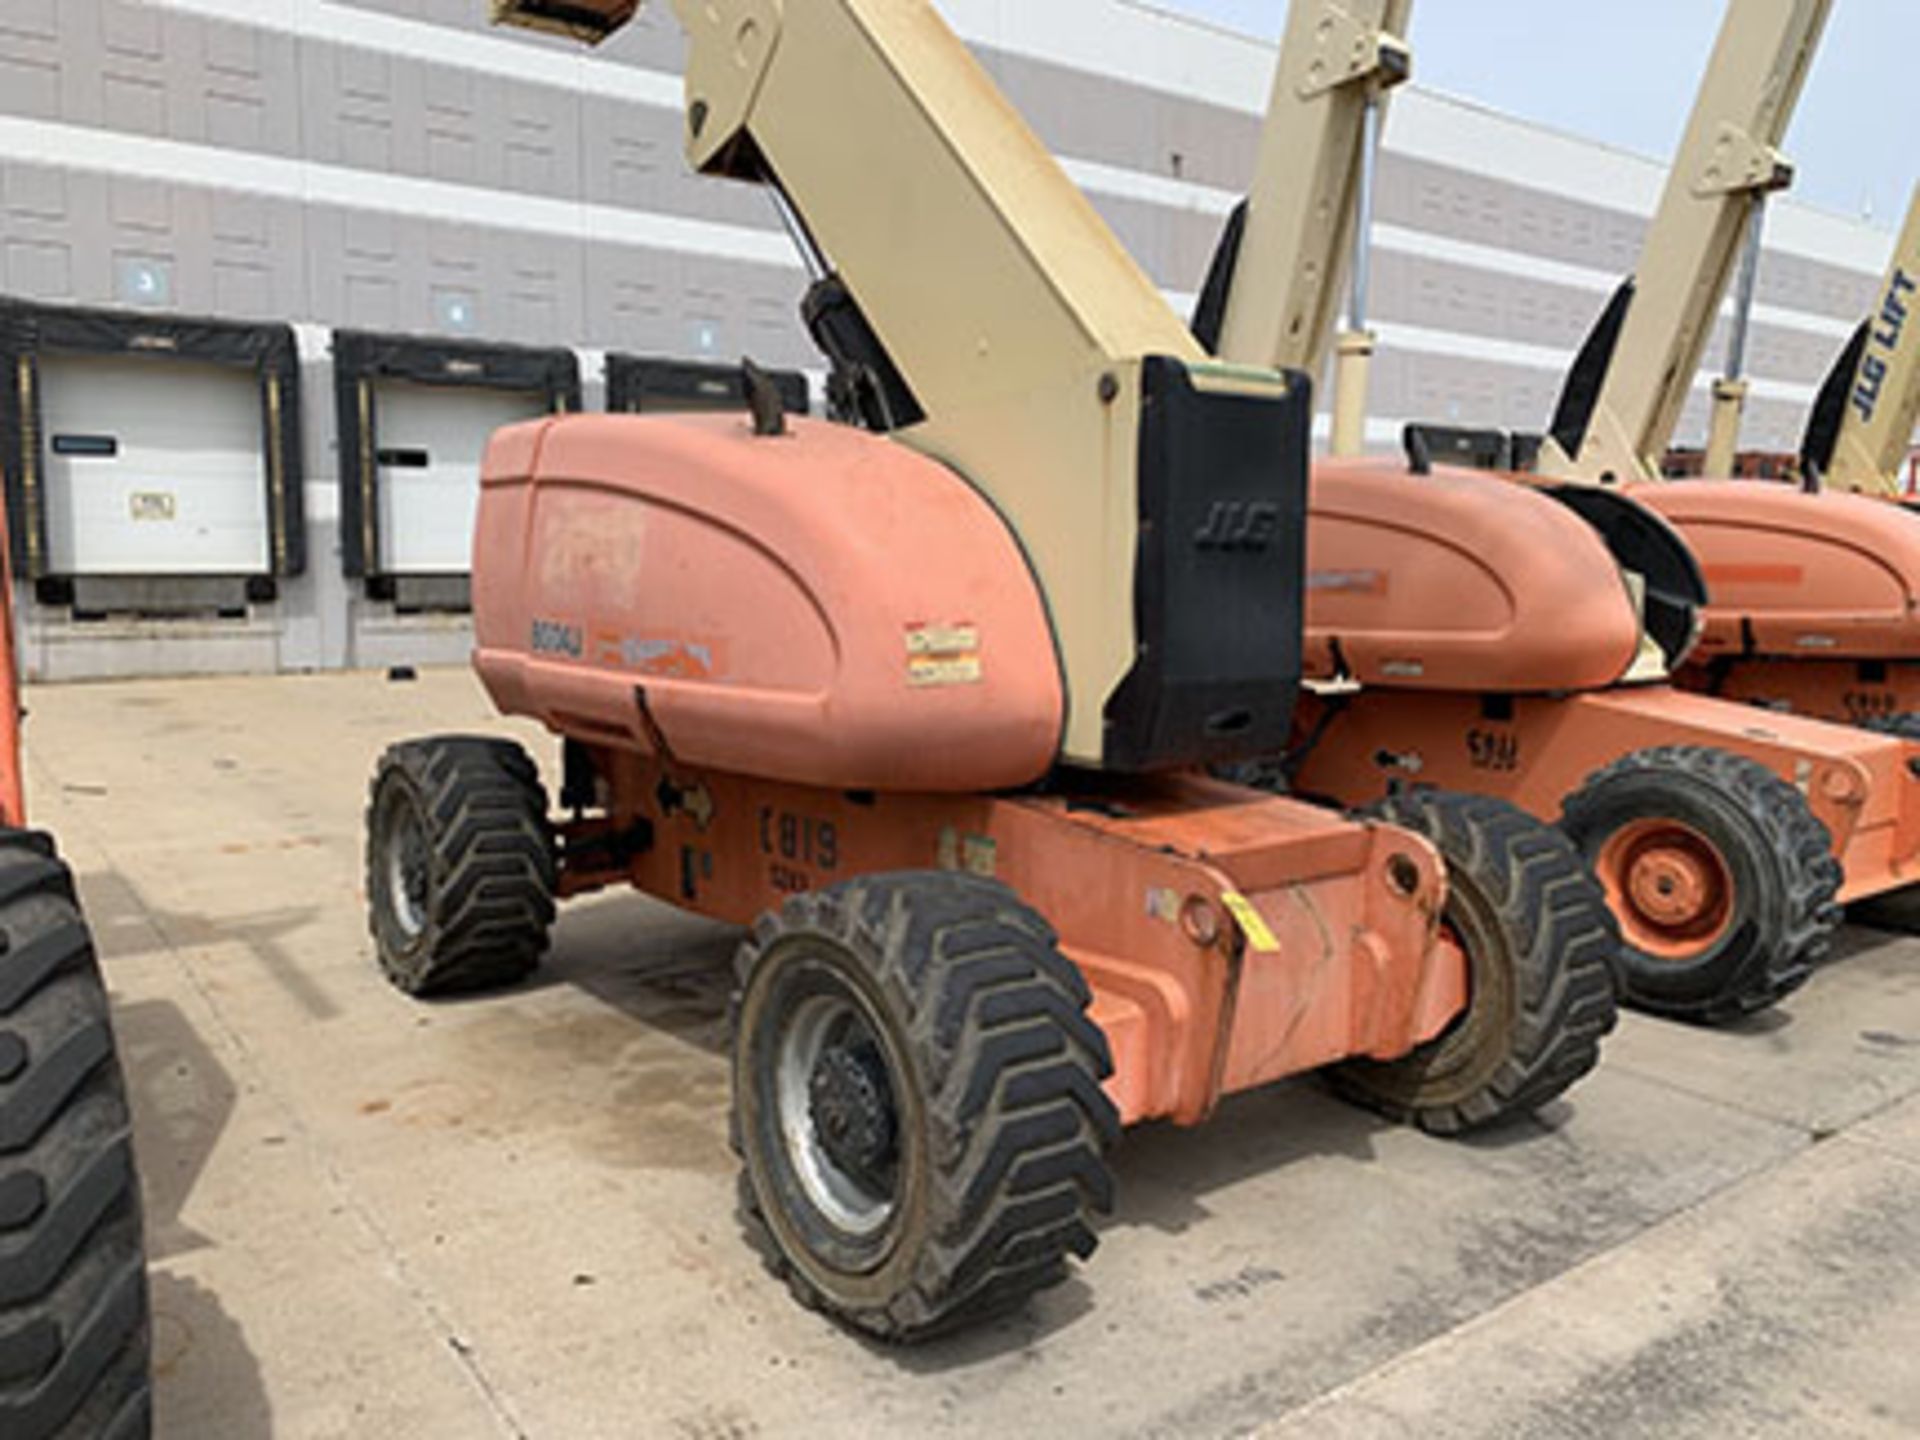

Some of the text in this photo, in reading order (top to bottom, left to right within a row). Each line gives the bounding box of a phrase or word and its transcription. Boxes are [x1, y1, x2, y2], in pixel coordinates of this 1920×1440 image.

[1853, 269, 1916, 423] JLG LIFT
[1193, 500, 1279, 550] JLG
